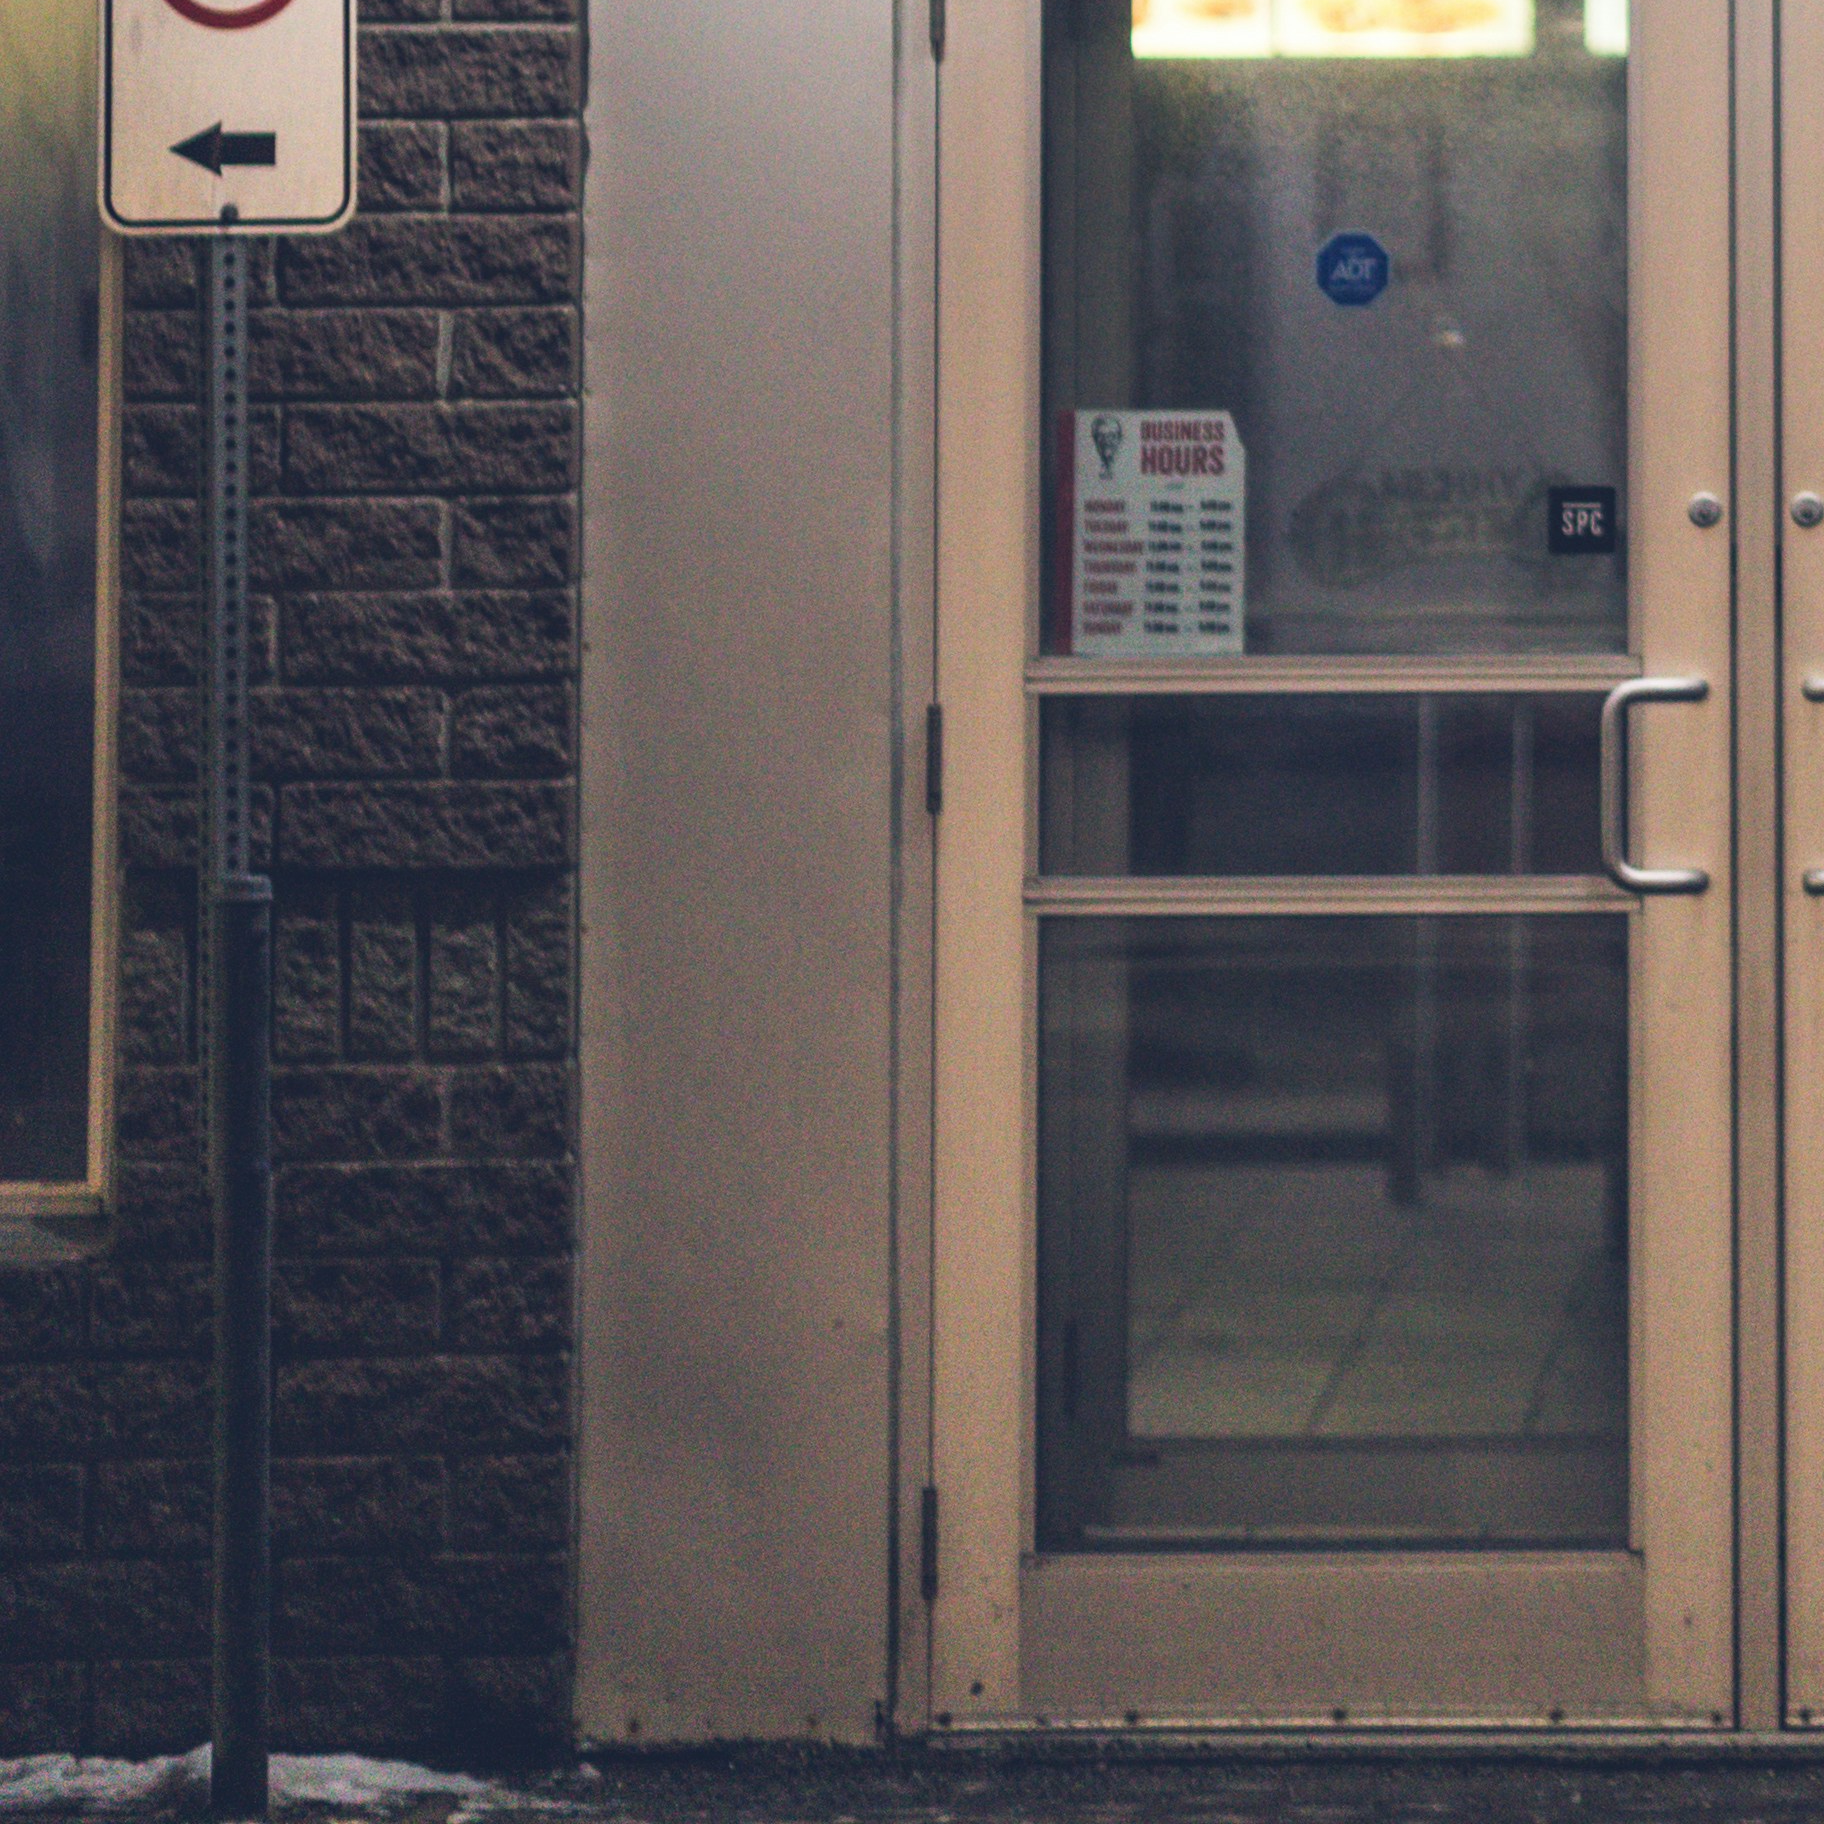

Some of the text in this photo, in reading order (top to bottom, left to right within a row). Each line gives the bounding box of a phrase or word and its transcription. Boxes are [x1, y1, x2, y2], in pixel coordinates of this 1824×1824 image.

[1140, 420, 1225, 442] BUSINESS
[1140, 446, 1225, 475] HOURS
[1561, 509, 1604, 537] SPC
